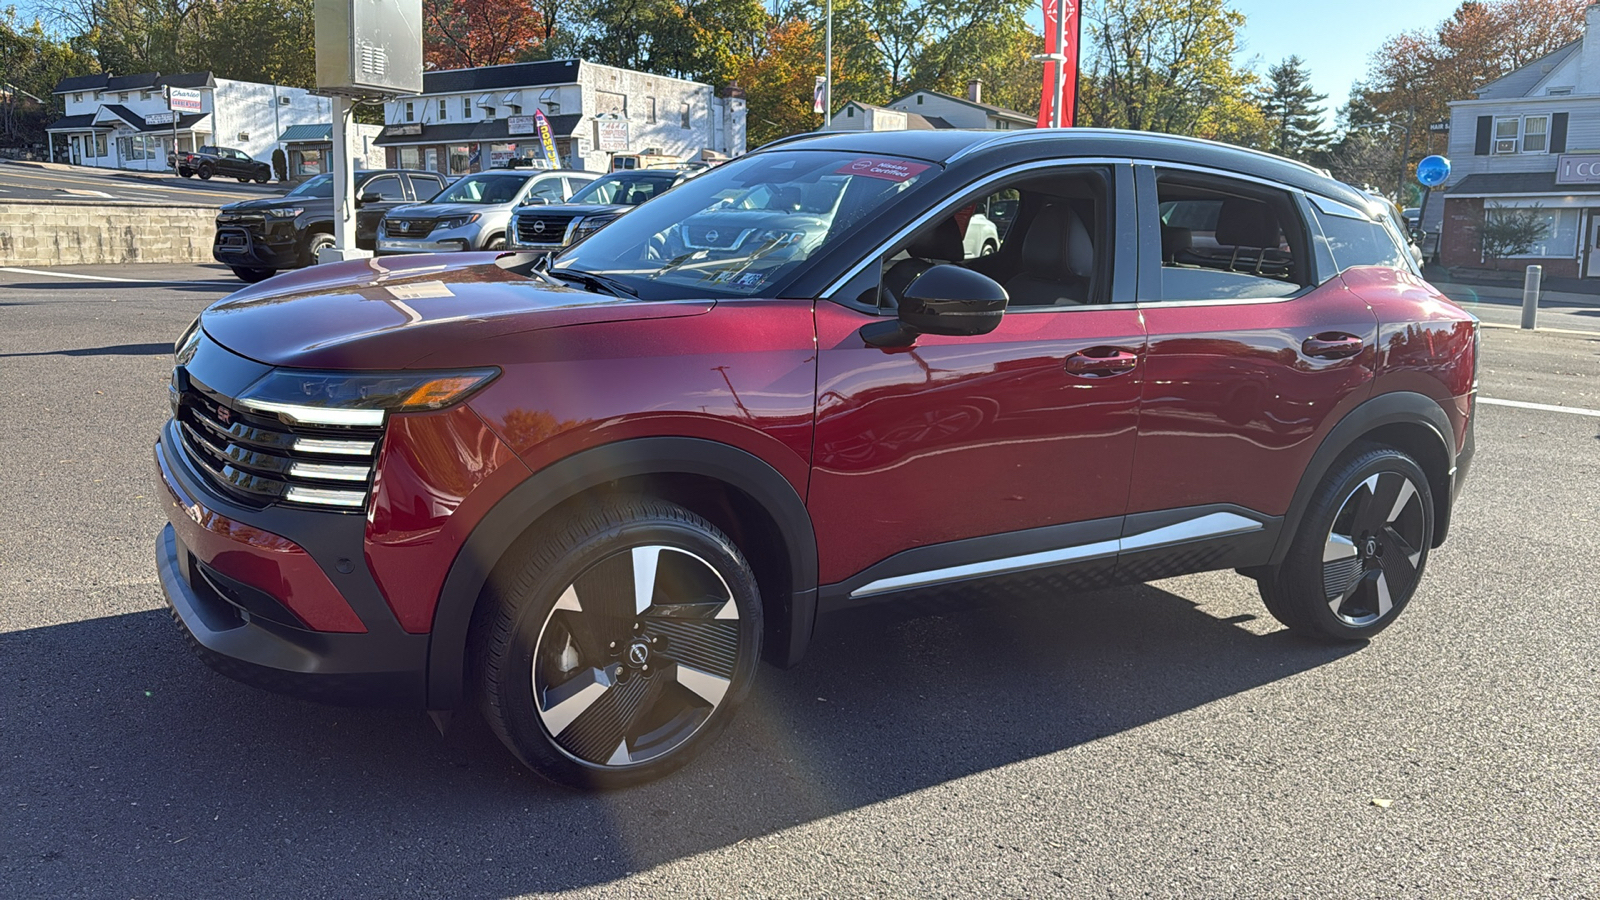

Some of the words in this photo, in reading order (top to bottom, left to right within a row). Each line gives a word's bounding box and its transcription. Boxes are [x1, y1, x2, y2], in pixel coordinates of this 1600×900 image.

[600, 129, 627, 137] COMPUTERS
[877, 162, 908, 171] Nissan
[870, 167, 909, 177] Certified
